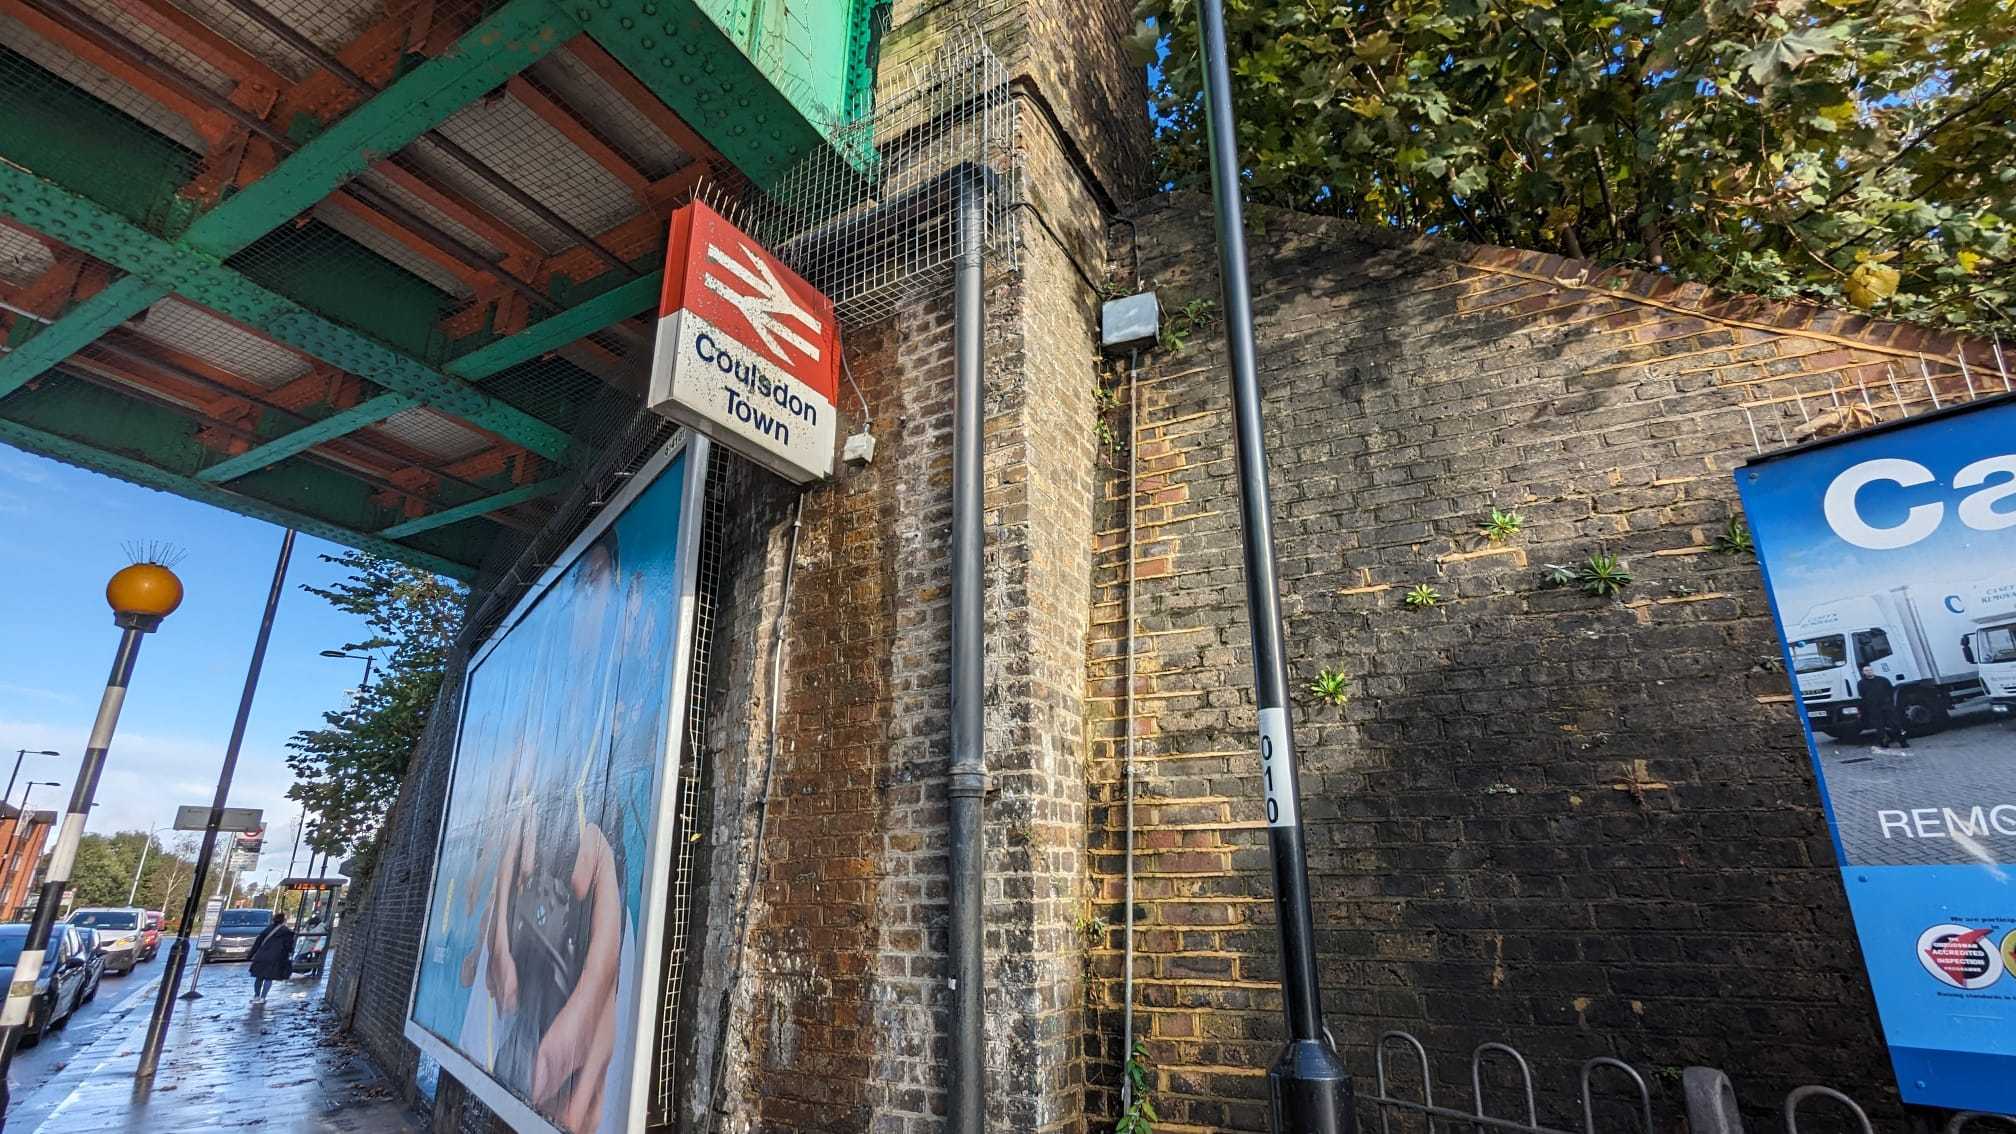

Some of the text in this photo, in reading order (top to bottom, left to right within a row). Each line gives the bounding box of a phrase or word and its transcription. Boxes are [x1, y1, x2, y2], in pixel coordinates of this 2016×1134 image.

[695, 333, 817, 425] Coulsdon
[723, 385, 789, 446] Town
[1261, 735, 1278, 824] 010
